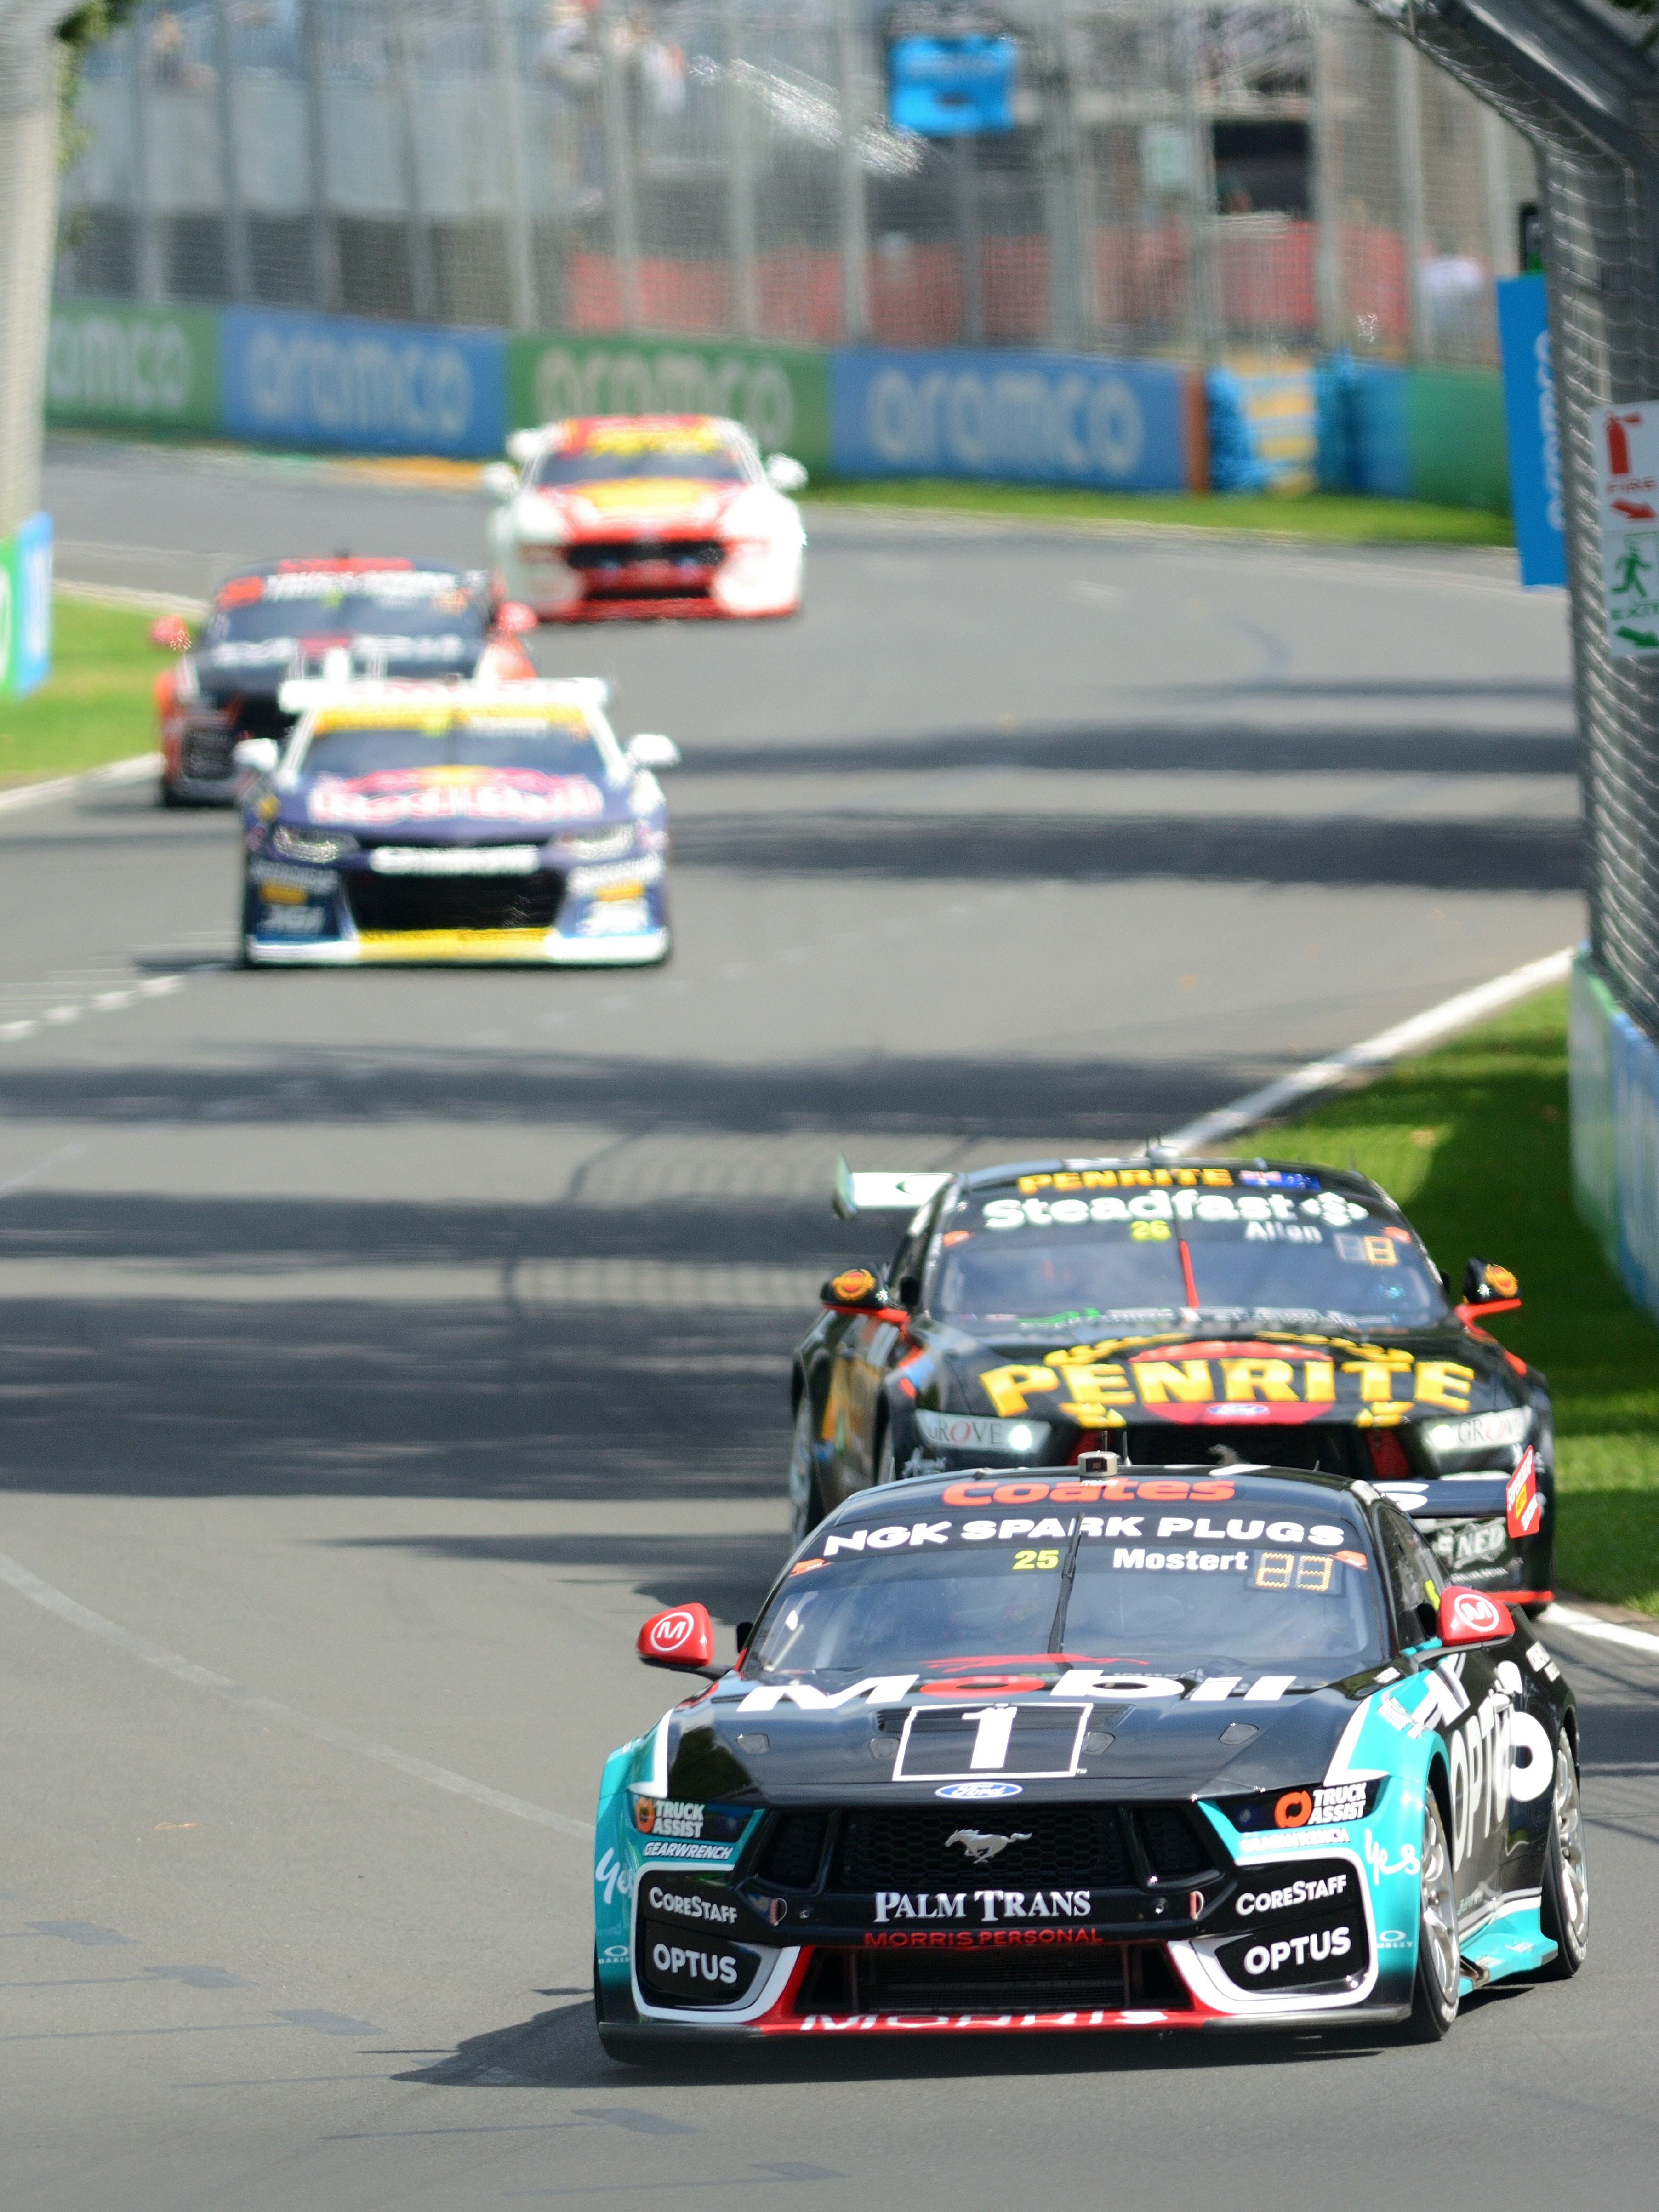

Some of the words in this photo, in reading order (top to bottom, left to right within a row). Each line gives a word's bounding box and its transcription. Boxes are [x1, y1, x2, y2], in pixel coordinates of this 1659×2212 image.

[48, 313, 193, 416] amco
[866, 367, 1143, 478] aramco
[1017, 1168, 1234, 1195] PENRITE
[982, 1189, 1294, 1229] Steadfast
[1130, 1220, 1172, 1242] 26
[1244, 1220, 1323, 1243] Allen
[980, 1357, 1474, 1418] PENRITE
[942, 1477, 1236, 1506] Coates
[824, 1521, 952, 1556] NGK
[961, 1517, 1145, 1540] SPARK
[1157, 1517, 1345, 1546] PLUGS
[1012, 1549, 1059, 1570] 25
[1113, 1548, 1249, 1571] Mostert
[737, 1670, 1296, 1711] Mobil
[962, 1706, 1017, 1769] 1
[1313, 1782, 1367, 1807] TRUCK
[655, 1800, 705, 1820] TRUCK
[1307, 1800, 1365, 1825] ASSIST
[653, 1818, 704, 1838] ASSIST
[644, 1841, 733, 1860] GEARWRENCH
[873, 1891, 967, 1923] PALM
[975, 1890, 1091, 1922] TRANS
[864, 1931, 974, 1947] MORRIS
[979, 1927, 1104, 1945] PERSONAL
[1244, 1927, 1351, 1975] OPTUS
[653, 1944, 737, 1984] OPTUS
